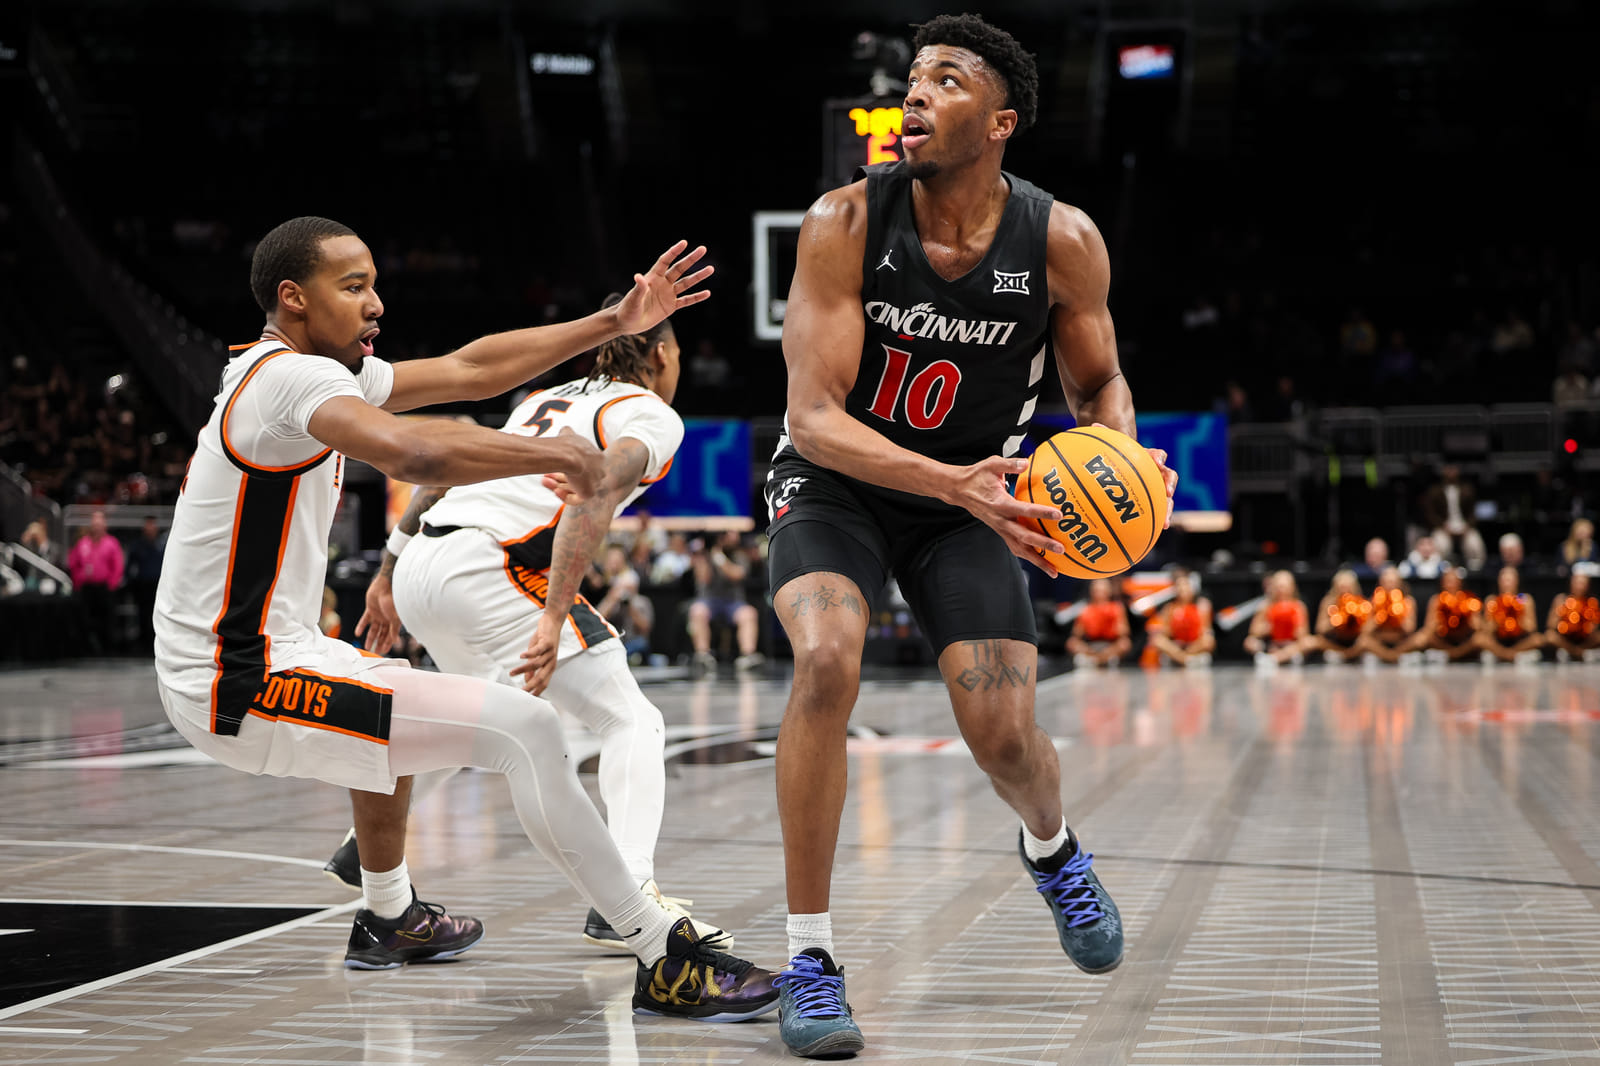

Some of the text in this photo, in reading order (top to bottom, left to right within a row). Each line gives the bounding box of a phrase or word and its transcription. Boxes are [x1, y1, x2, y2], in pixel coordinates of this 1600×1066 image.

[865, 301, 1018, 345] CINCINNATI
[866, 343, 962, 430] 10
[1042, 466, 1109, 564] Wilson
[1084, 455, 1140, 524] NCAA
